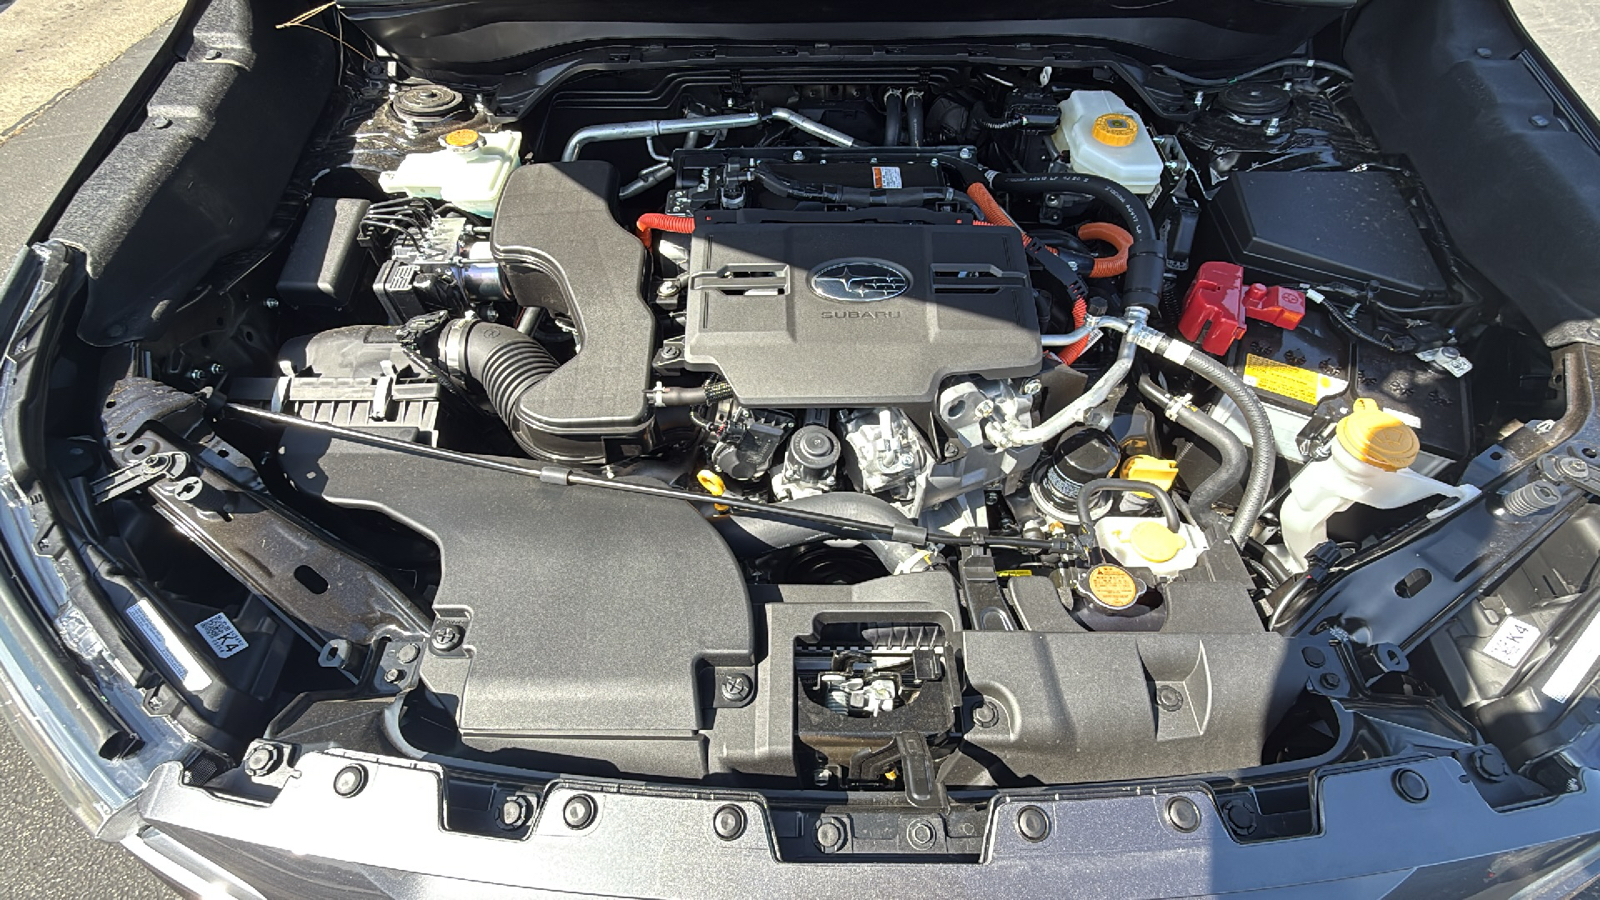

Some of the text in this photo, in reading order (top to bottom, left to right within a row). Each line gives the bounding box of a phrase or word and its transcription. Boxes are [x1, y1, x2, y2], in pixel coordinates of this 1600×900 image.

[821, 311, 901, 319] SUBARU
[216, 631, 239, 652] K4
[1506, 624, 1529, 644] K4
